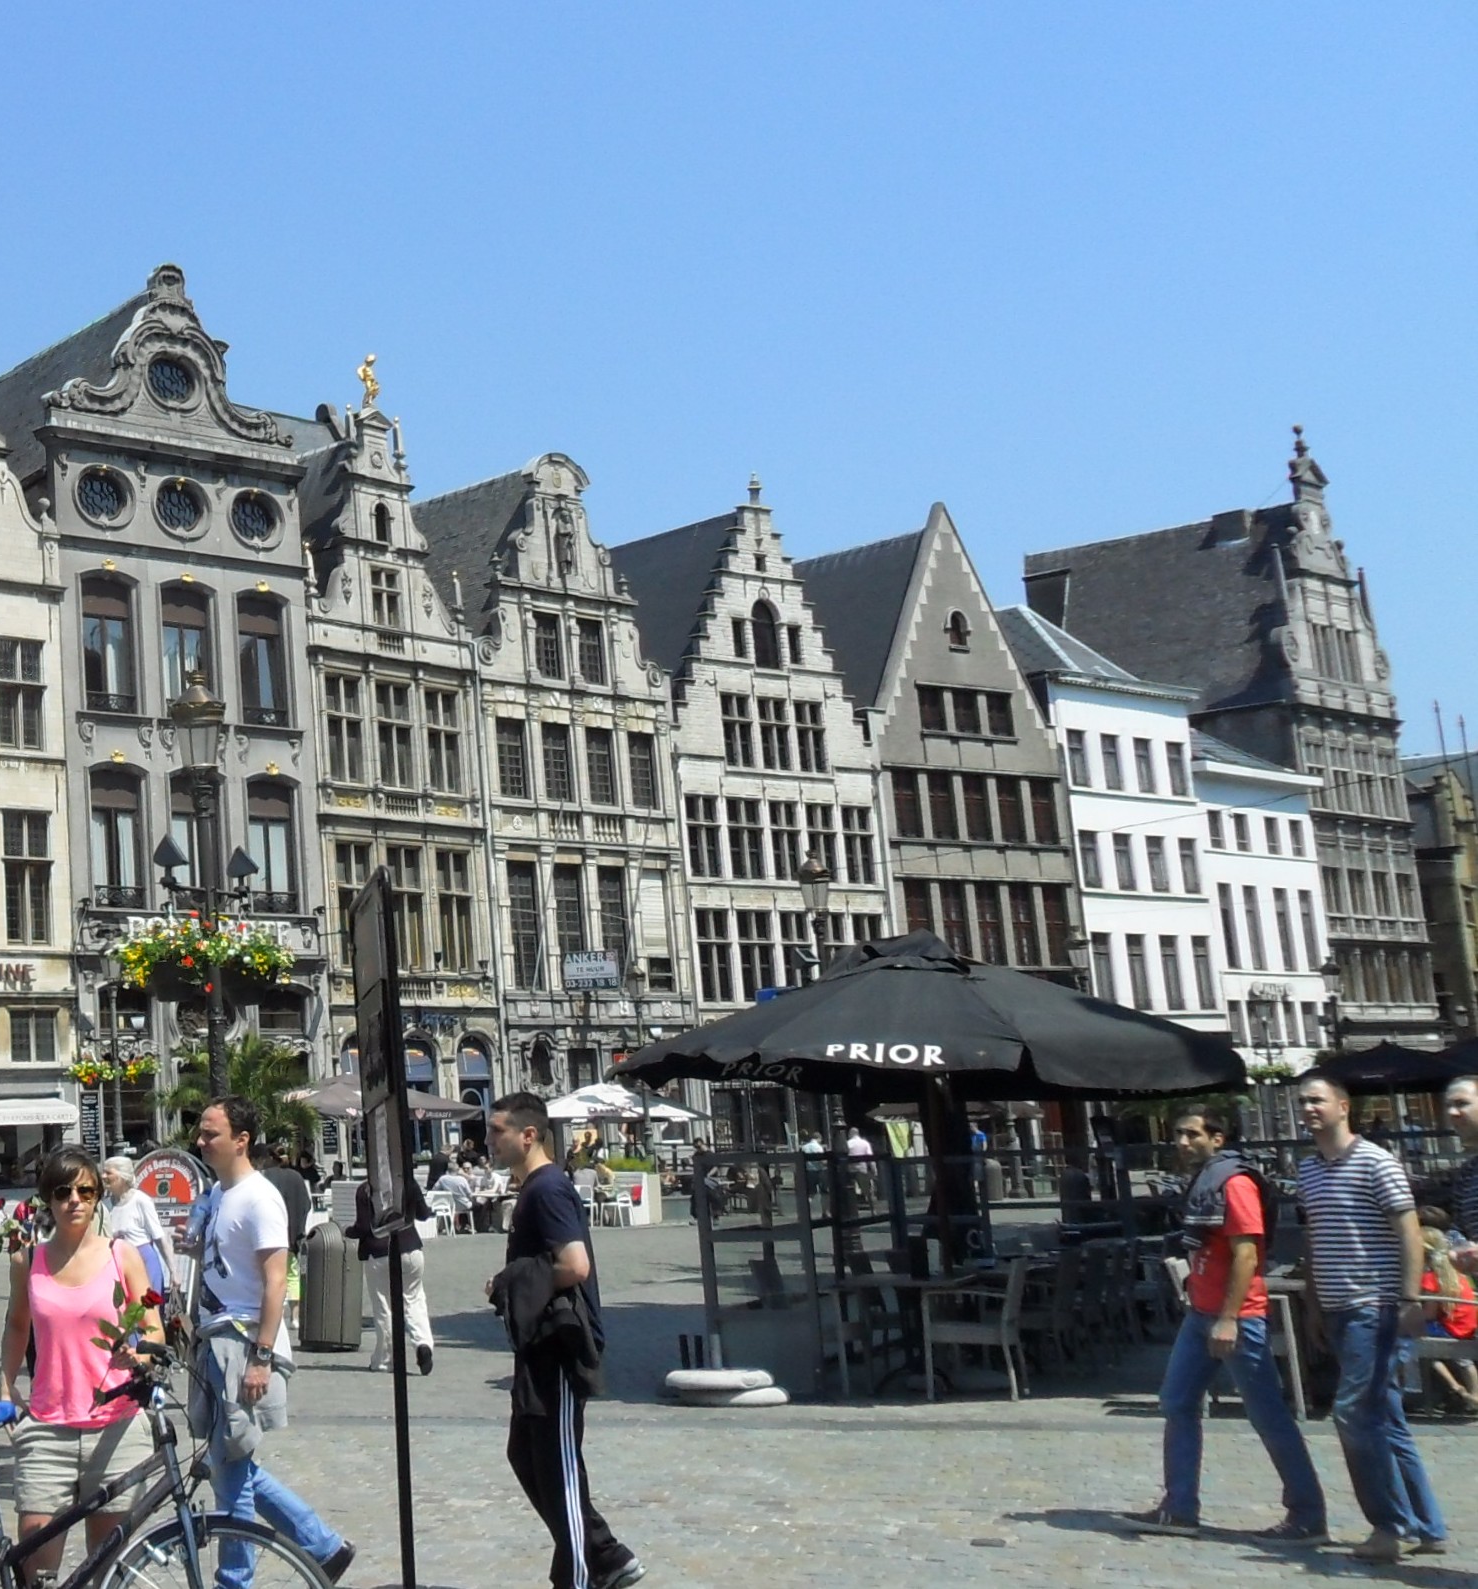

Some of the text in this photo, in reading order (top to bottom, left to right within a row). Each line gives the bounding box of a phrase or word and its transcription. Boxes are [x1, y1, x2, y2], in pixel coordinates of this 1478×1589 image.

[565, 952, 604, 963] ANKER
[825, 1042, 946, 1067] PRIOR
[721, 1060, 803, 1084] PRIOR
